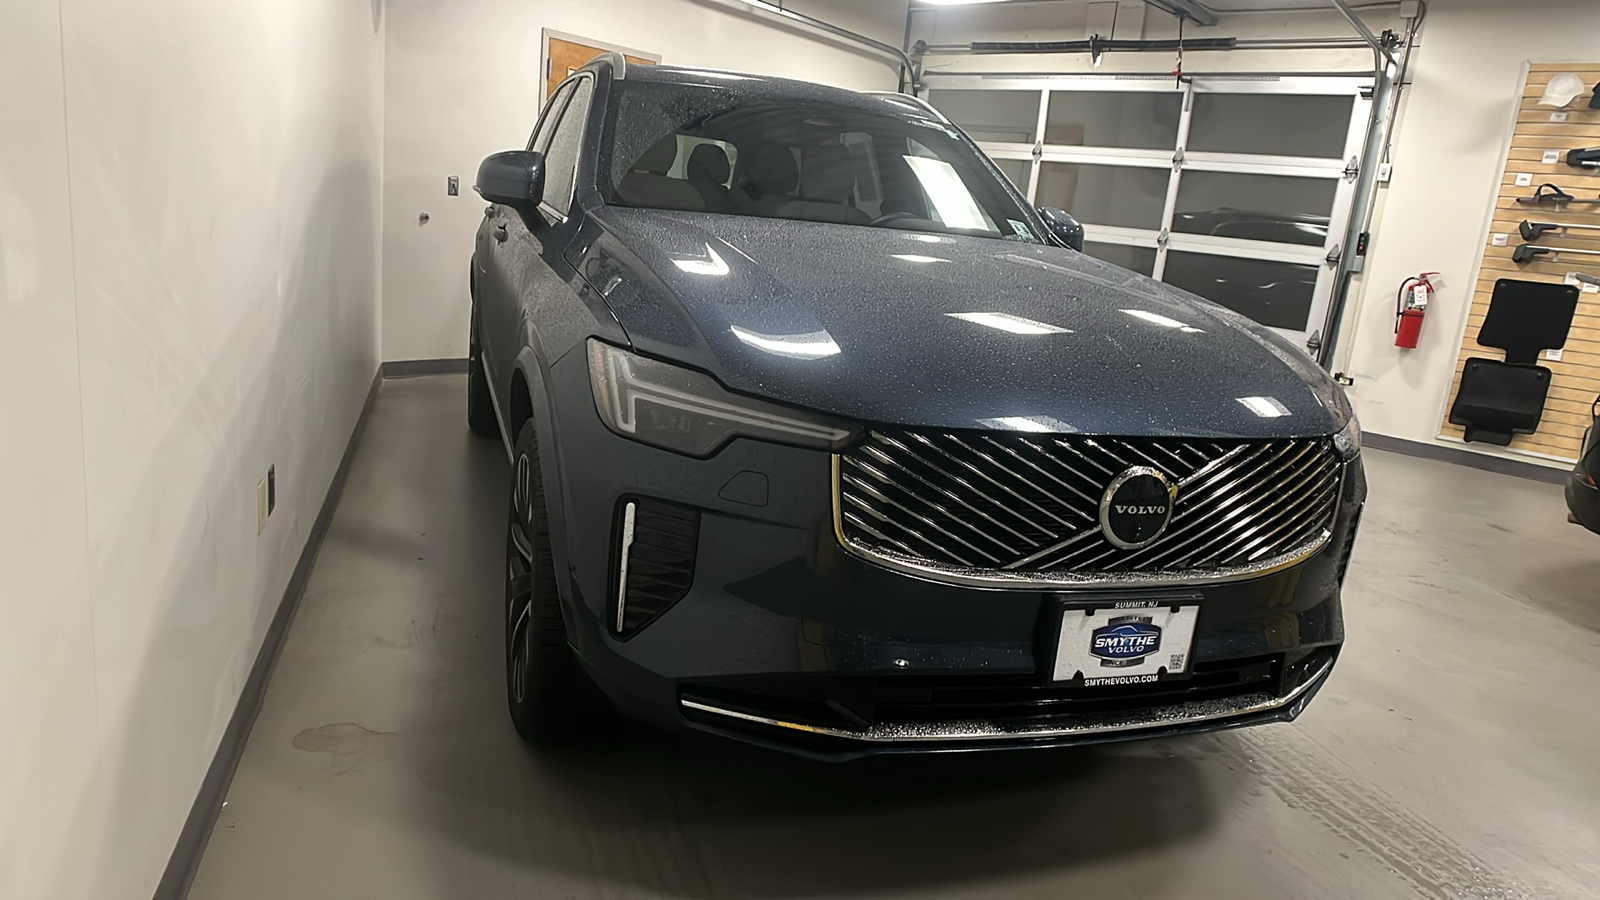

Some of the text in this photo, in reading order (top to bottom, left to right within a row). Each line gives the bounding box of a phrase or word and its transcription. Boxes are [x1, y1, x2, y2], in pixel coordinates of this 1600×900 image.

[1115, 505, 1166, 515] VOLVO
[1095, 636, 1157, 648] SMYTHE
[1108, 645, 1145, 654] VOLVO
[1084, 675, 1159, 687] SMYTHEVOLVO.COM
